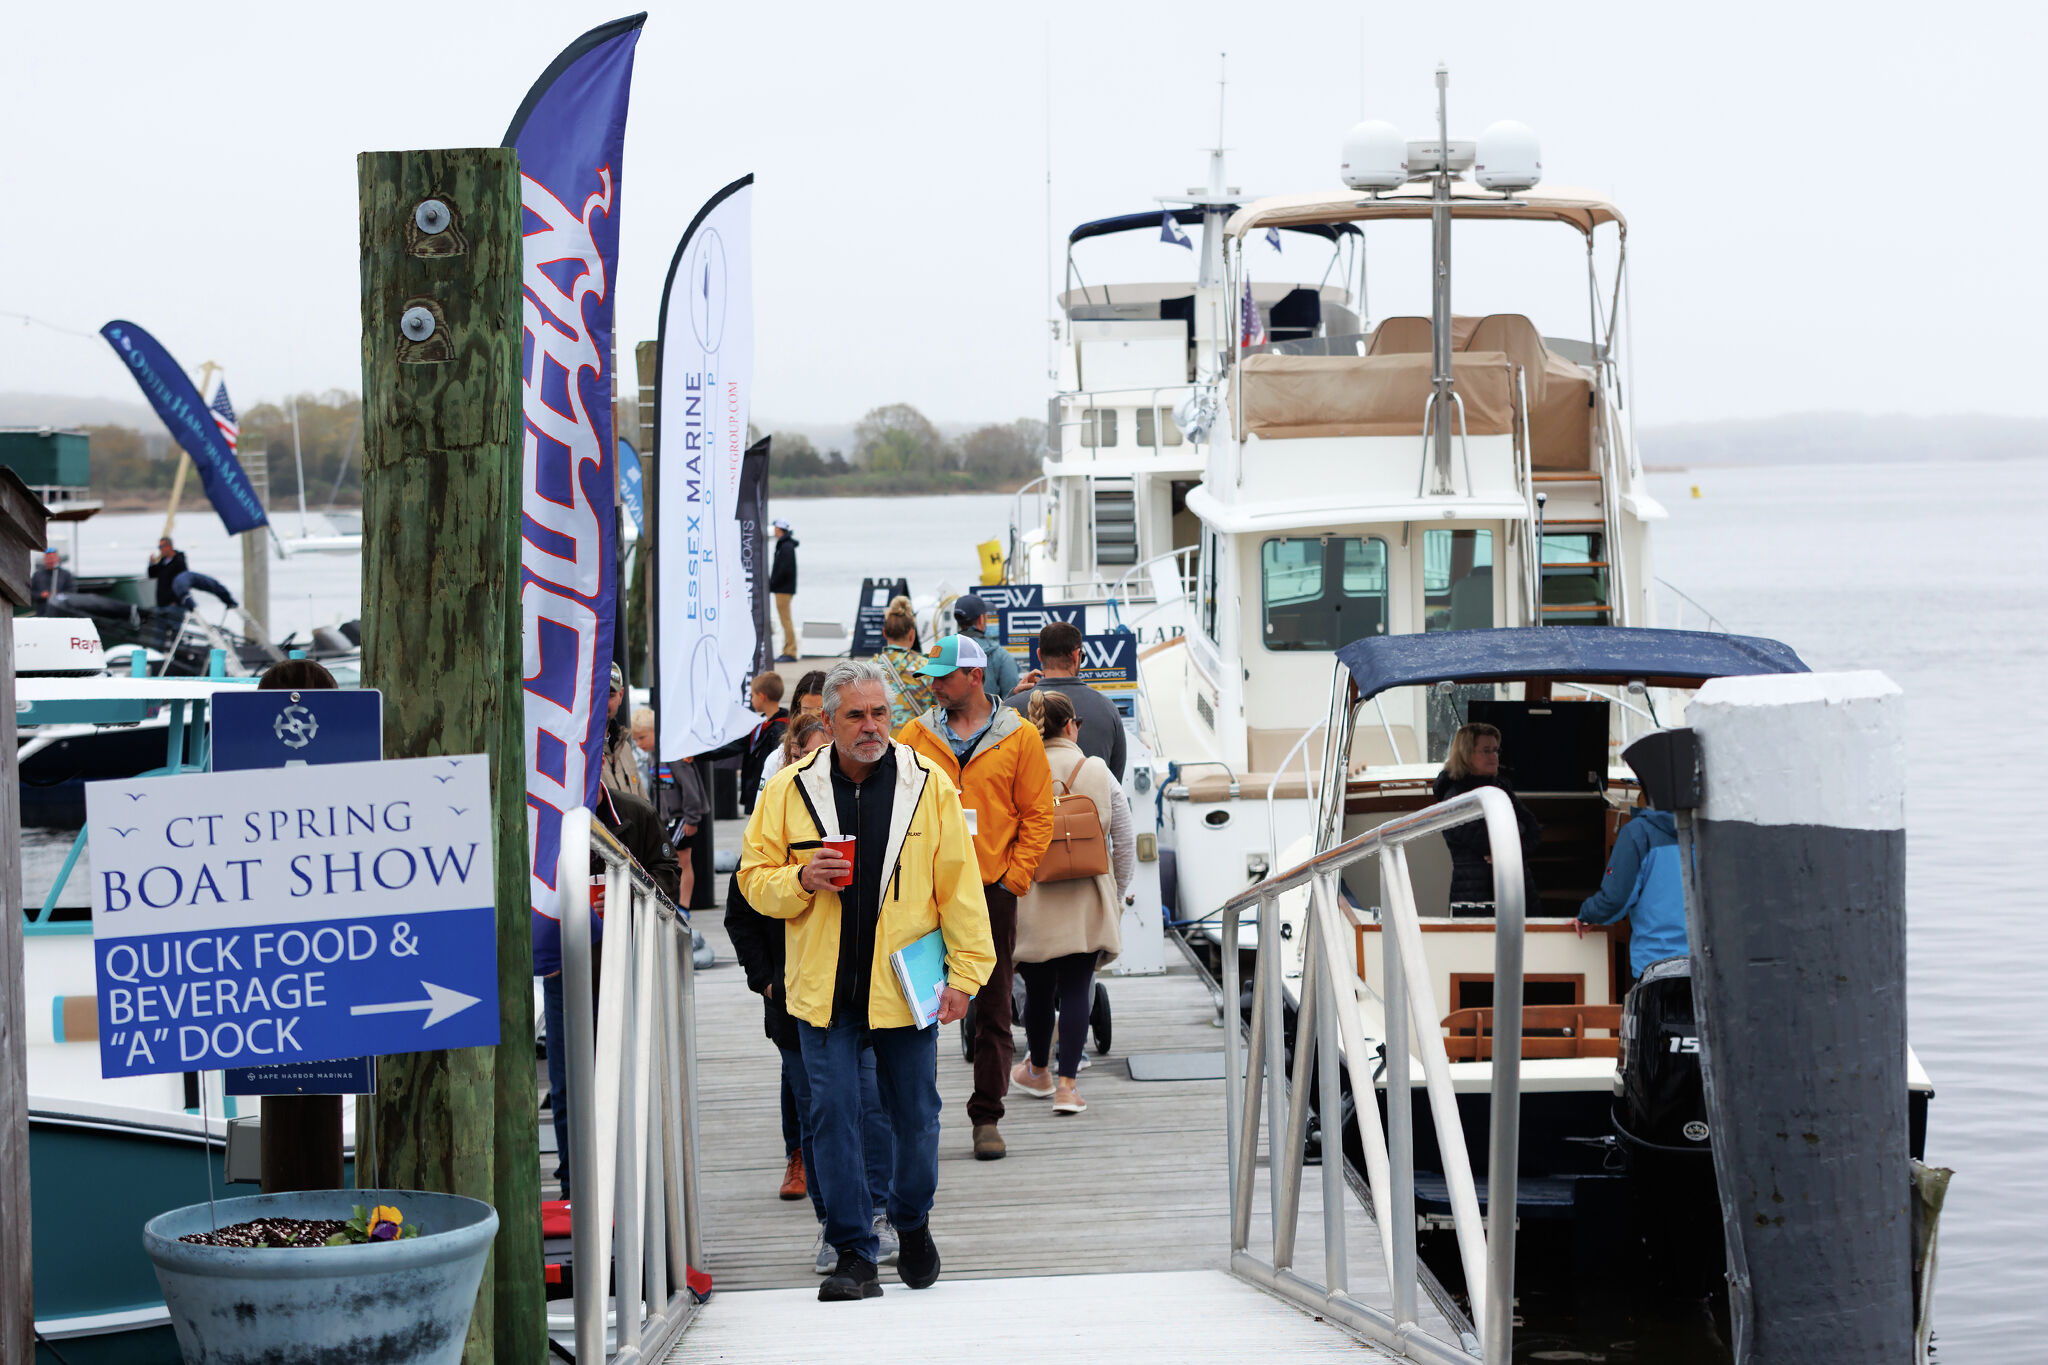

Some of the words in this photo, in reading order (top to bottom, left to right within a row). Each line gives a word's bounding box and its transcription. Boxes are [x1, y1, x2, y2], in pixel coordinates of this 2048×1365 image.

[684, 371, 702, 504] MARINE
[685, 516, 701, 621] ESSEX
[1096, 670, 1127, 678] WORKS
[166, 814, 223, 849] CT
[244, 801, 413, 843] SPRING
[101, 858, 262, 914] BOAT
[289, 842, 481, 898] SHOW
[105, 935, 243, 984] QUICK
[253, 925, 378, 969] FOOD
[389, 921, 420, 959] &
[110, 971, 327, 1026] BEVERAGE
[179, 1016, 303, 1063] DOCK
